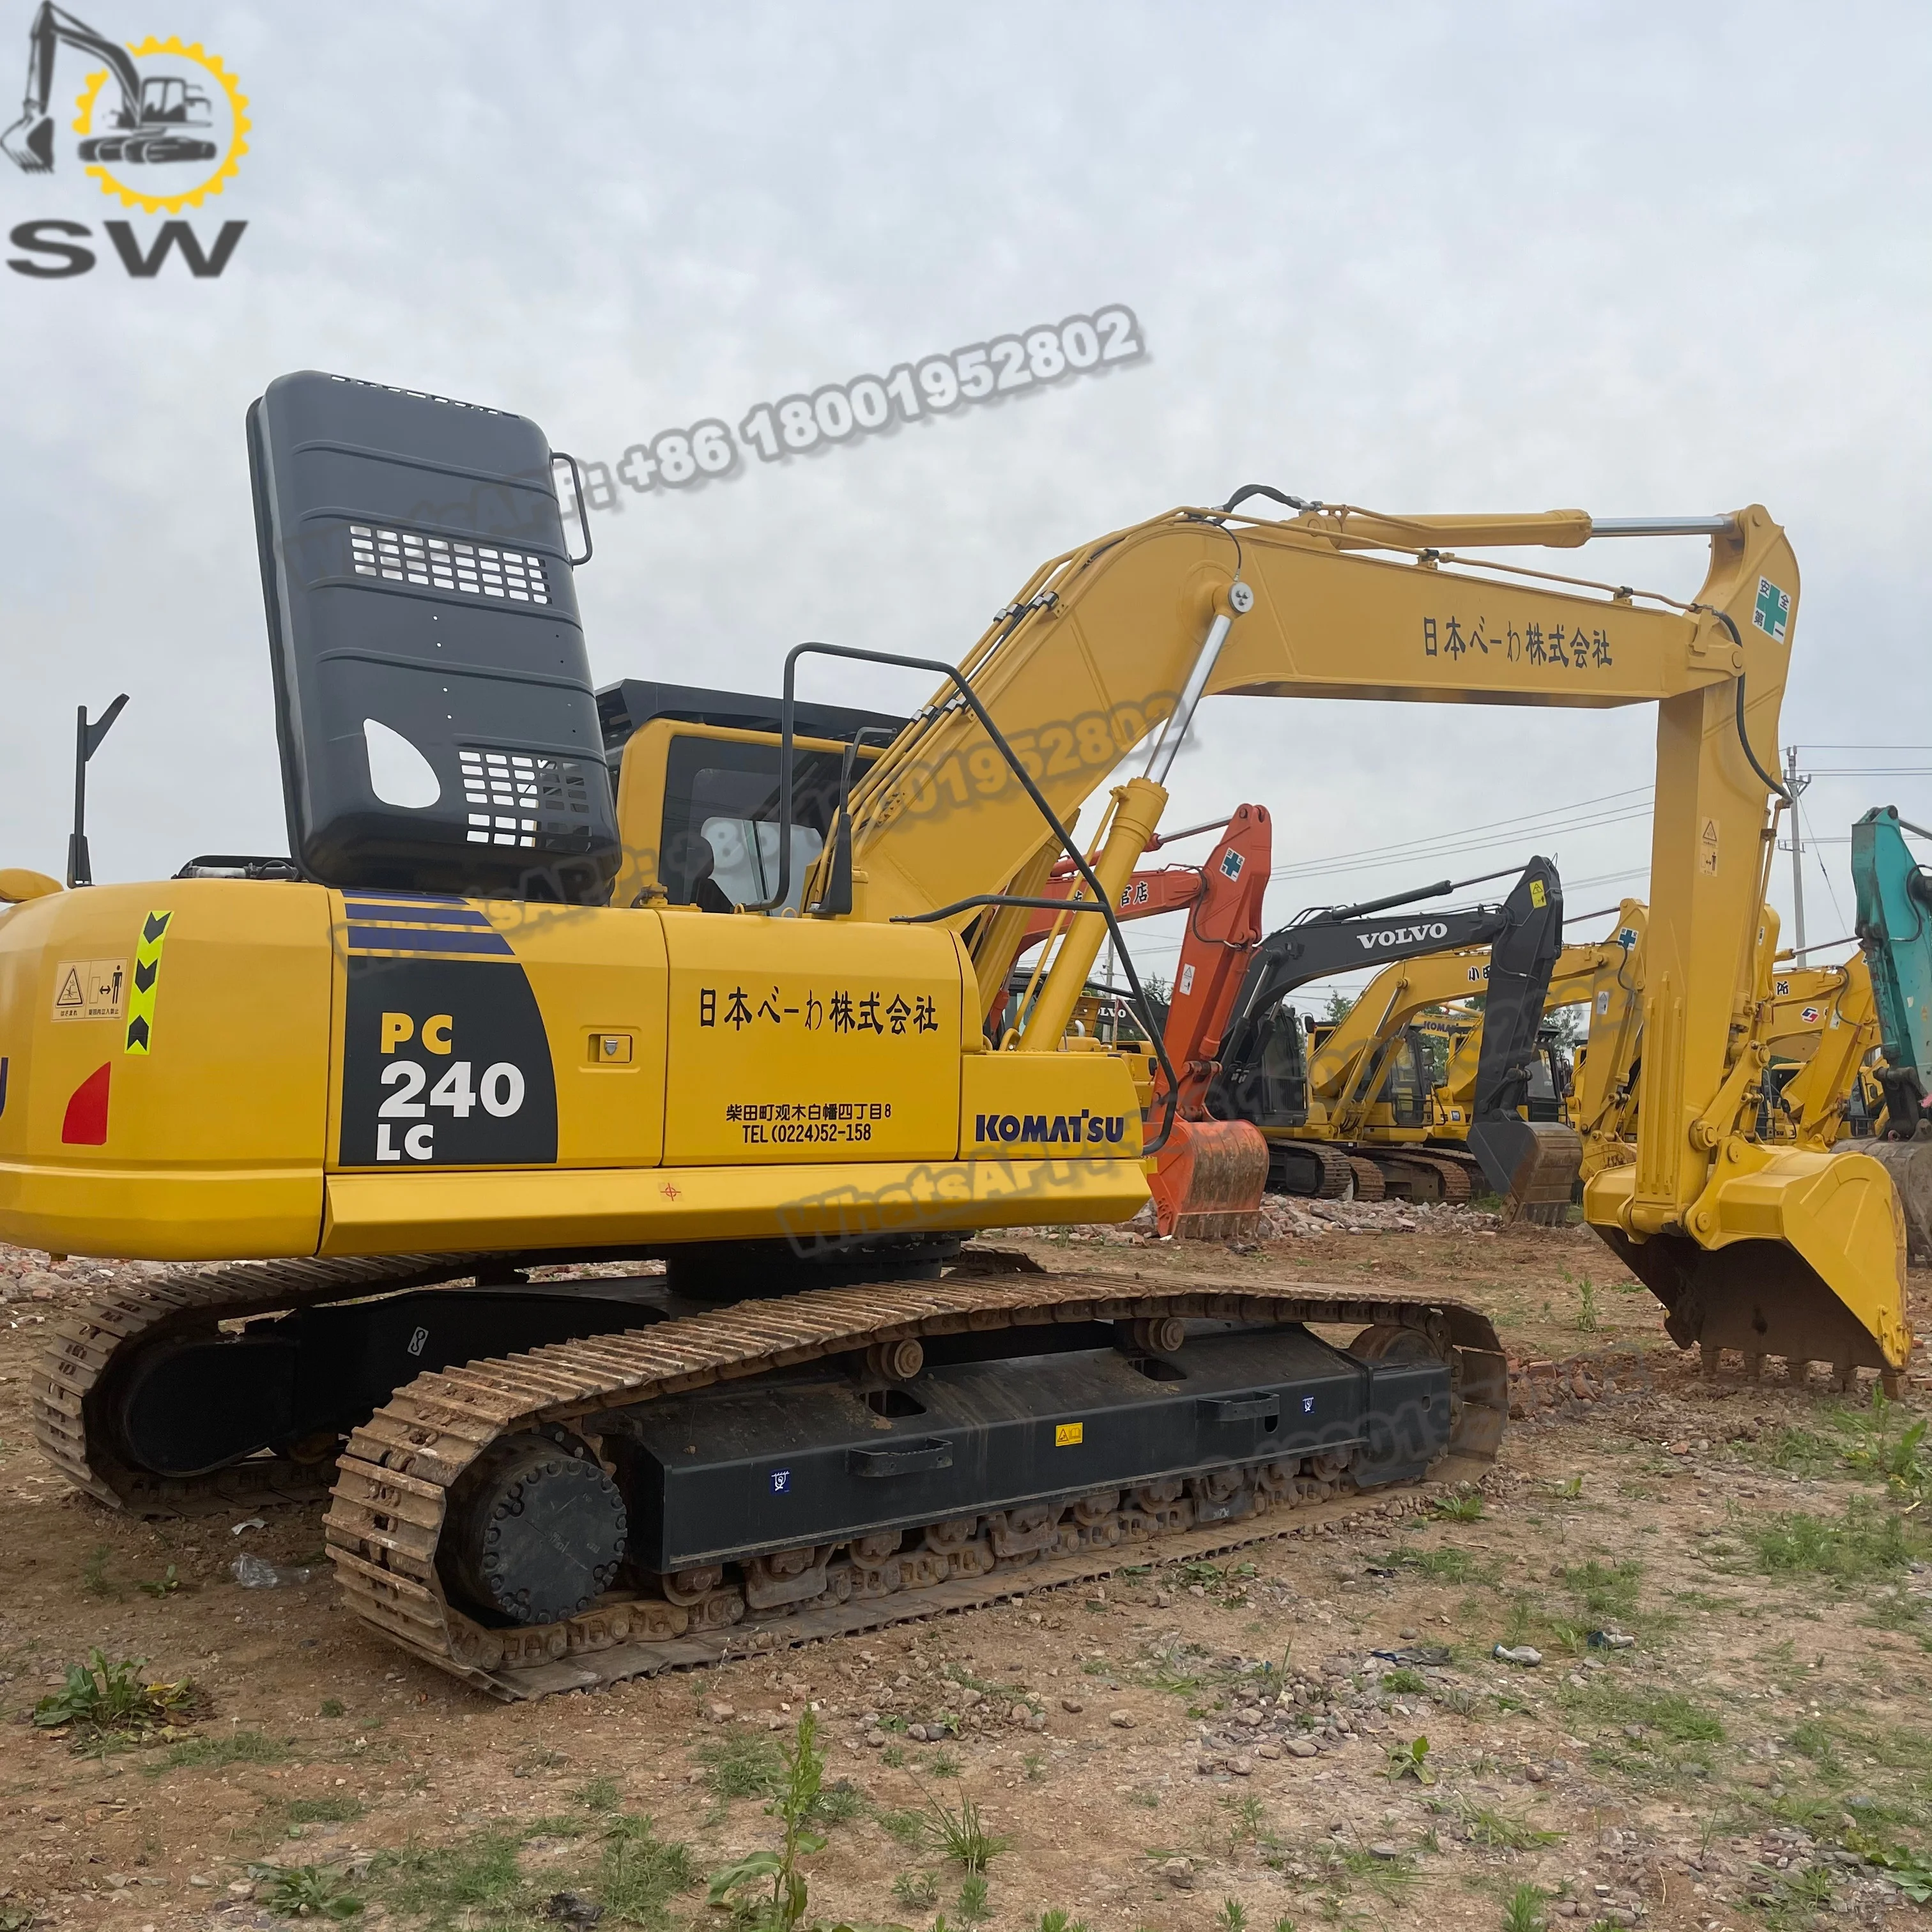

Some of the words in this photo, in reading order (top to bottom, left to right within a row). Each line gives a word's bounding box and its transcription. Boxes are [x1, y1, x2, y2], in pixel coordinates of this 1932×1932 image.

[1356, 923, 1448, 949] VOLVO
[381, 1012, 453, 1054] PC
[378, 1060, 525, 1117] 240
[376, 1124, 434, 1161] LC
[976, 1109, 1124, 1142] KOMATSU
